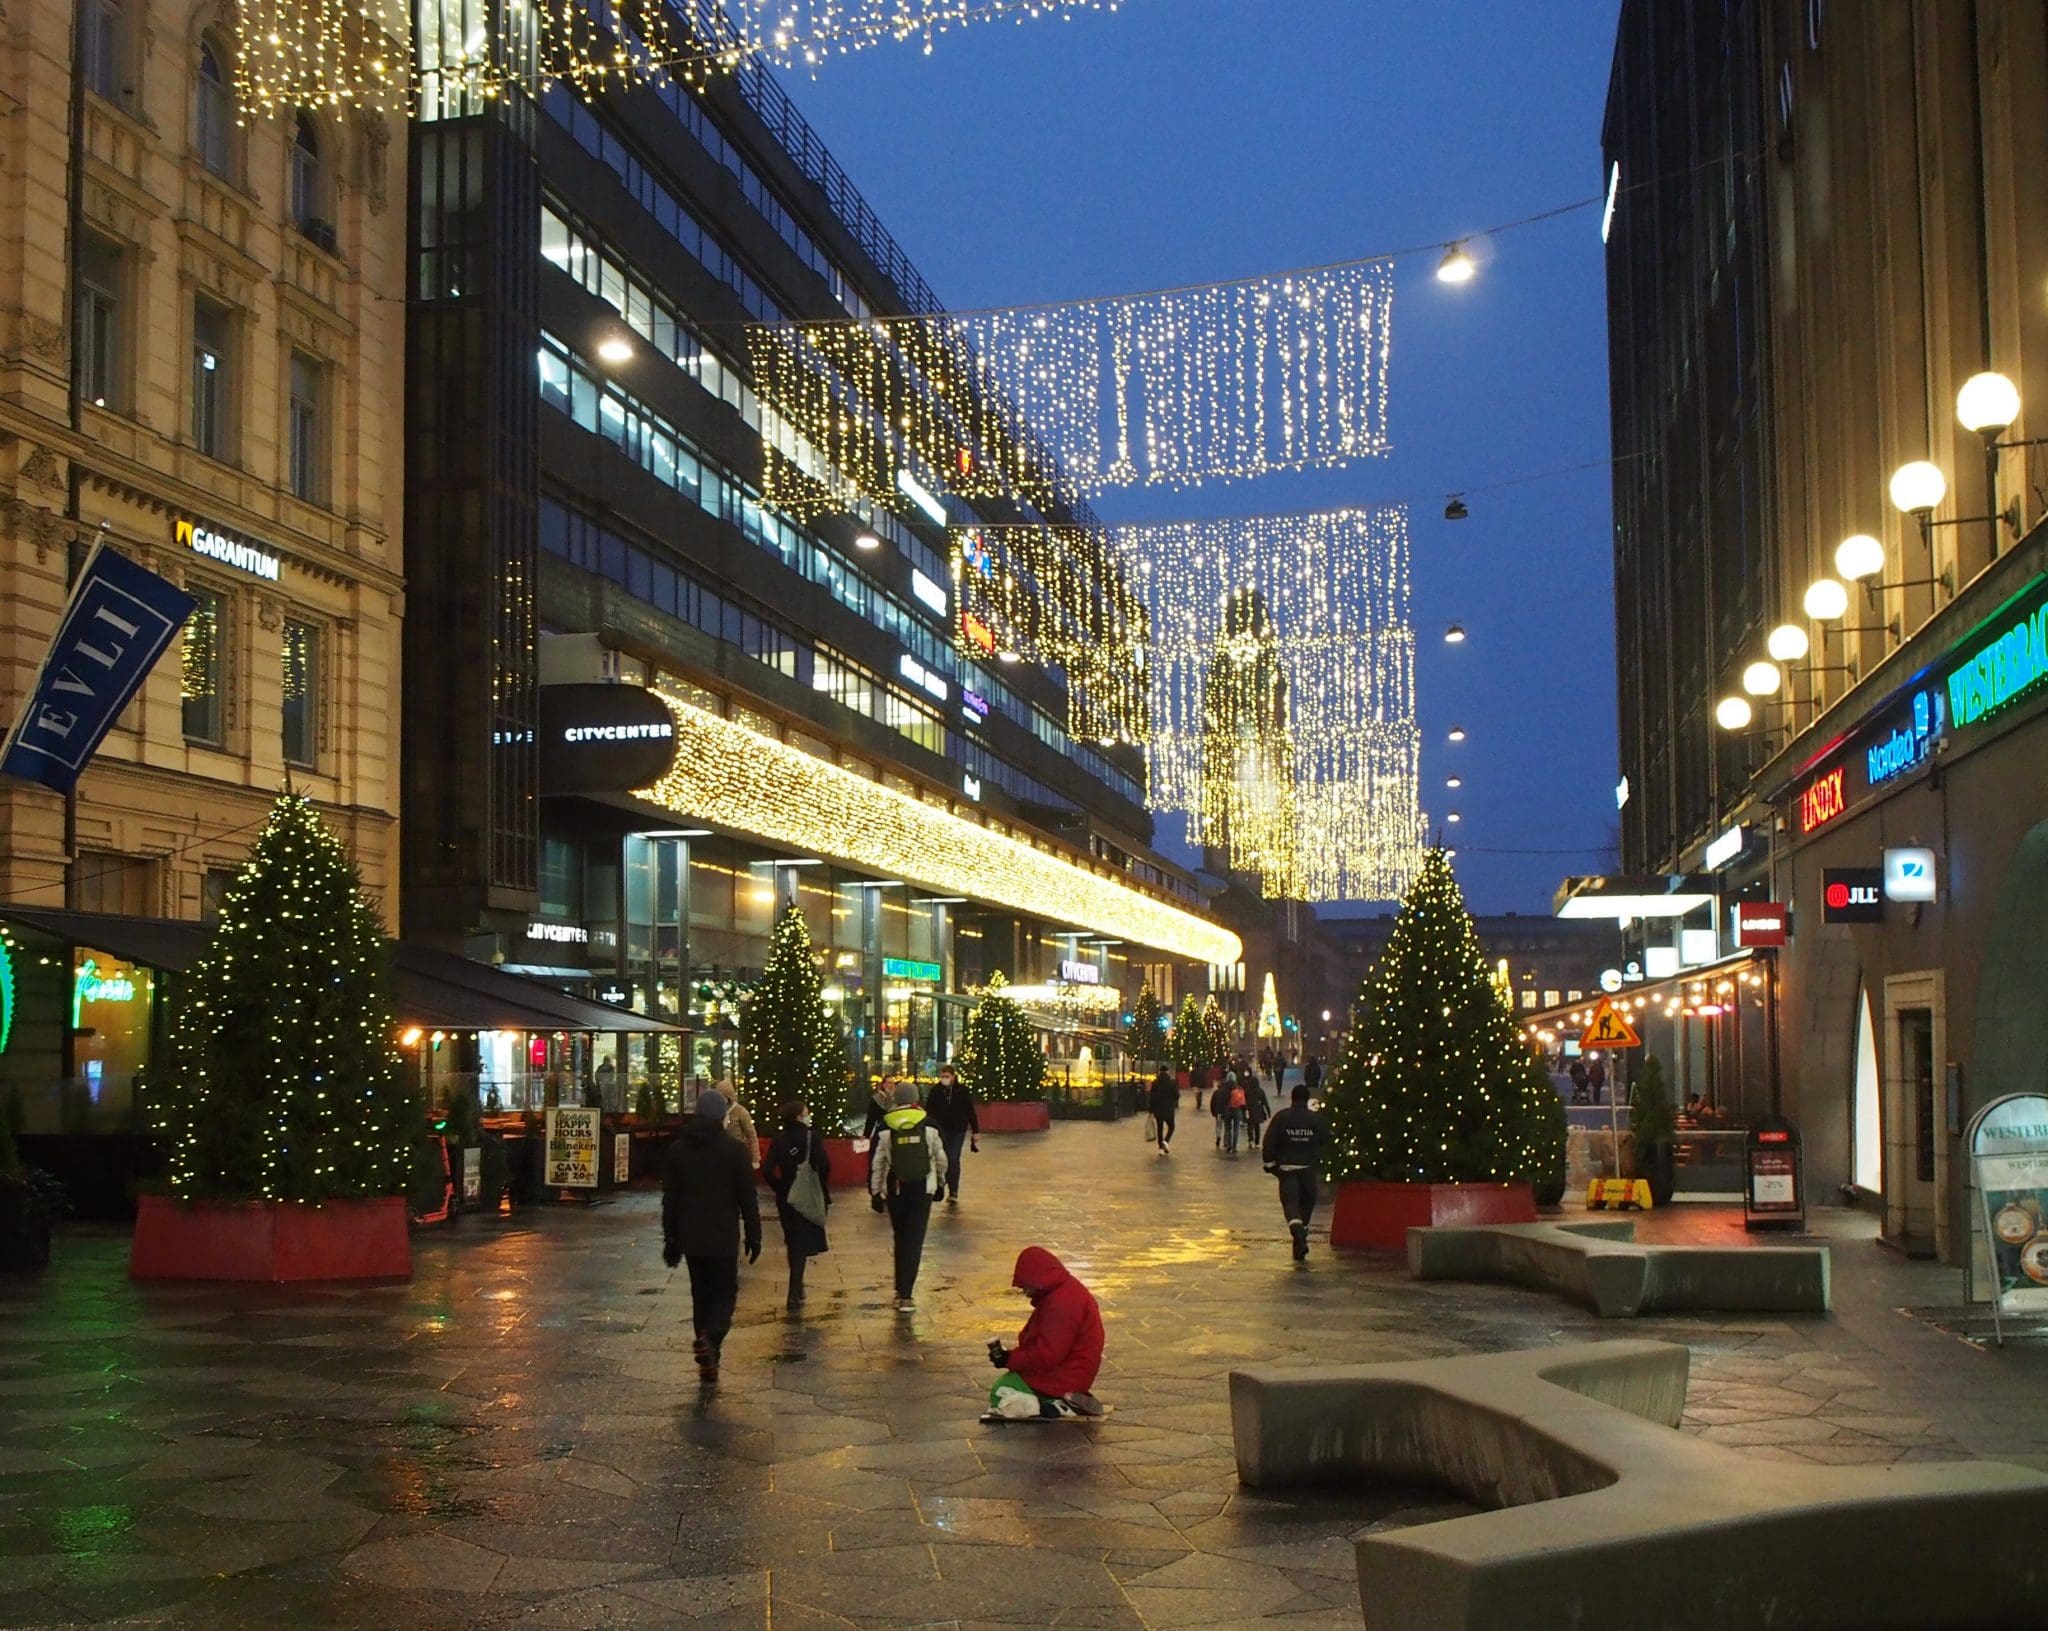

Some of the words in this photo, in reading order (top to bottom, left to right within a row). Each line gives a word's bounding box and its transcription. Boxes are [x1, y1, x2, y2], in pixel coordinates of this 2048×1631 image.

[191, 528, 279, 581] GARANTUM
[37, 604, 140, 739] EVLI
[565, 724, 672, 742] CITYCENTER
[1868, 728, 1914, 785] Nordea
[1802, 768, 1844, 832] LINDEX
[1847, 887, 1878, 904] JLL
[527, 923, 588, 943] CITYCENTER
[554, 1129, 592, 1138] HOURS
[550, 1140, 597, 1151] Heineken
[557, 1163, 587, 1172] CAVA
